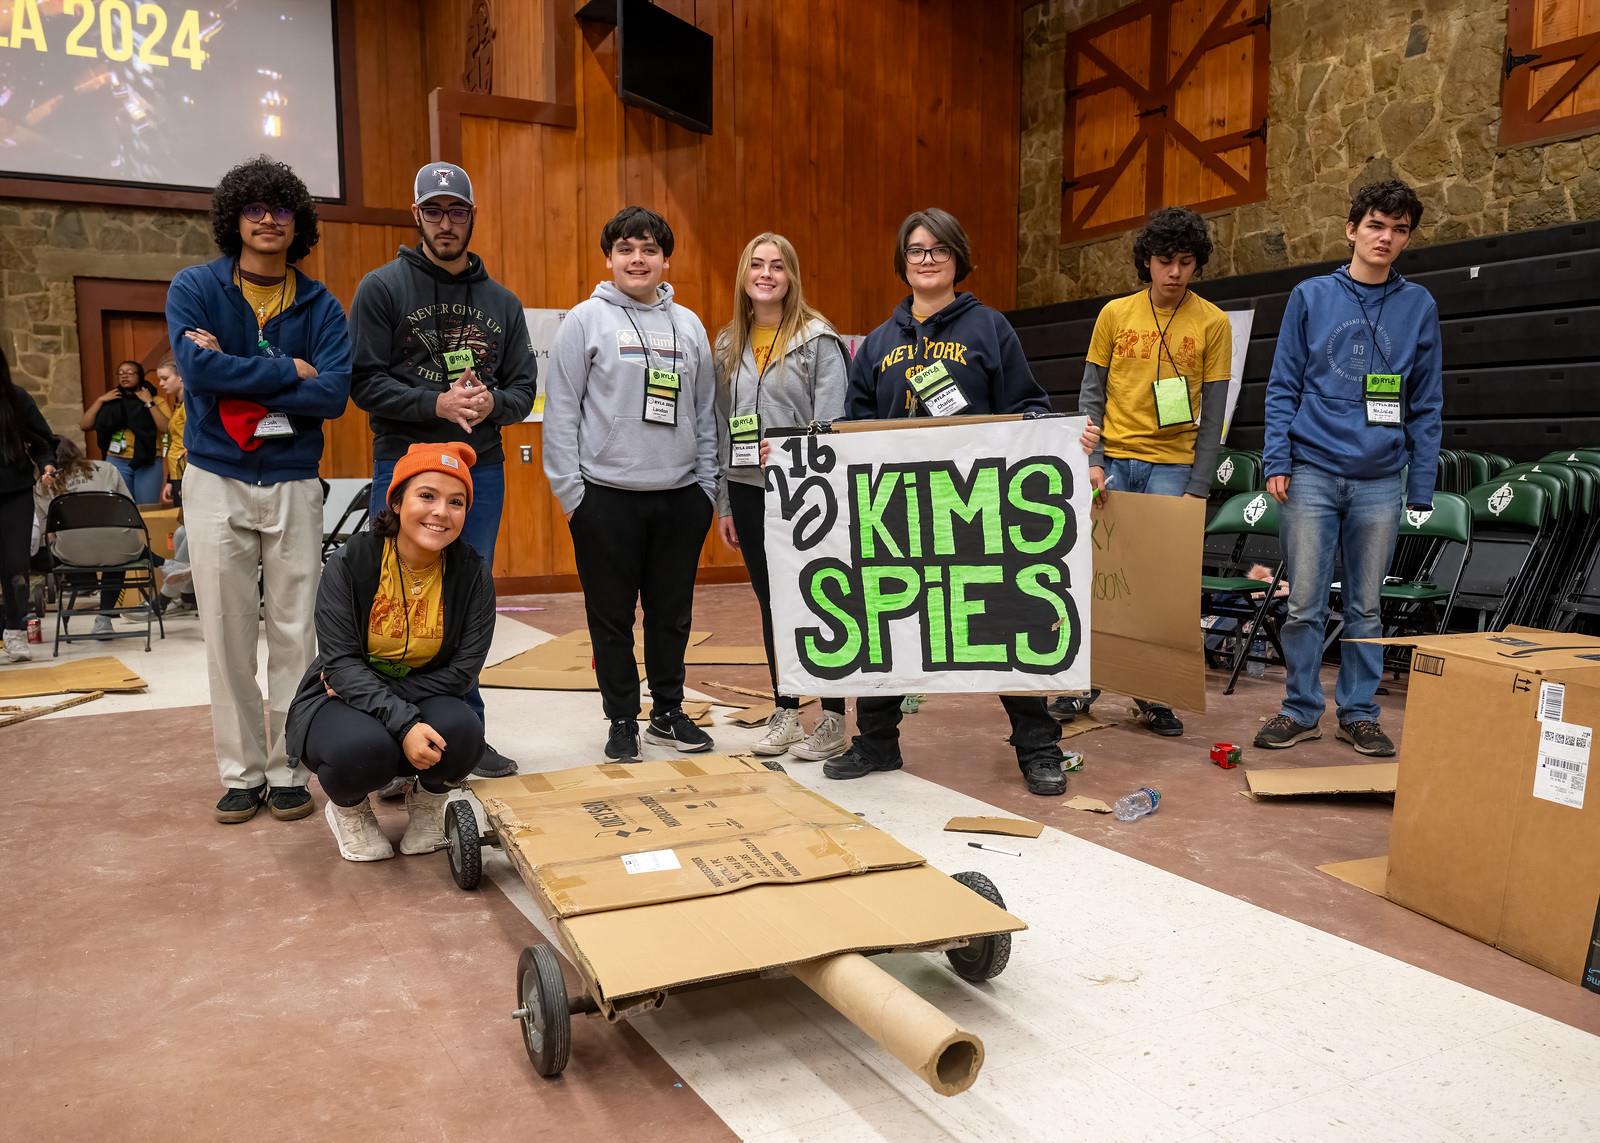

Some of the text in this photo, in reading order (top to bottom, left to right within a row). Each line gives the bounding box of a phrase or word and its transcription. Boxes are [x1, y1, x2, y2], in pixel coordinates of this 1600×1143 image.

[63, 0, 207, 71] 2024
[406, 303, 449, 325] NEVER
[452, 303, 484, 321] GIVE
[486, 318, 502, 335] UP
[1343, 318, 1360, 329] BRAND
[923, 336, 968, 366] YORK
[1353, 344, 1365, 356] 03
[416, 365, 444, 383] THE
[660, 373, 676, 381] RYLA
[922, 366, 940, 378] RYLA
[1380, 377, 1396, 385] RYLA
[652, 406, 669, 414] Landon
[937, 398, 955, 410] Charlie
[780, 437, 837, 479] 16
